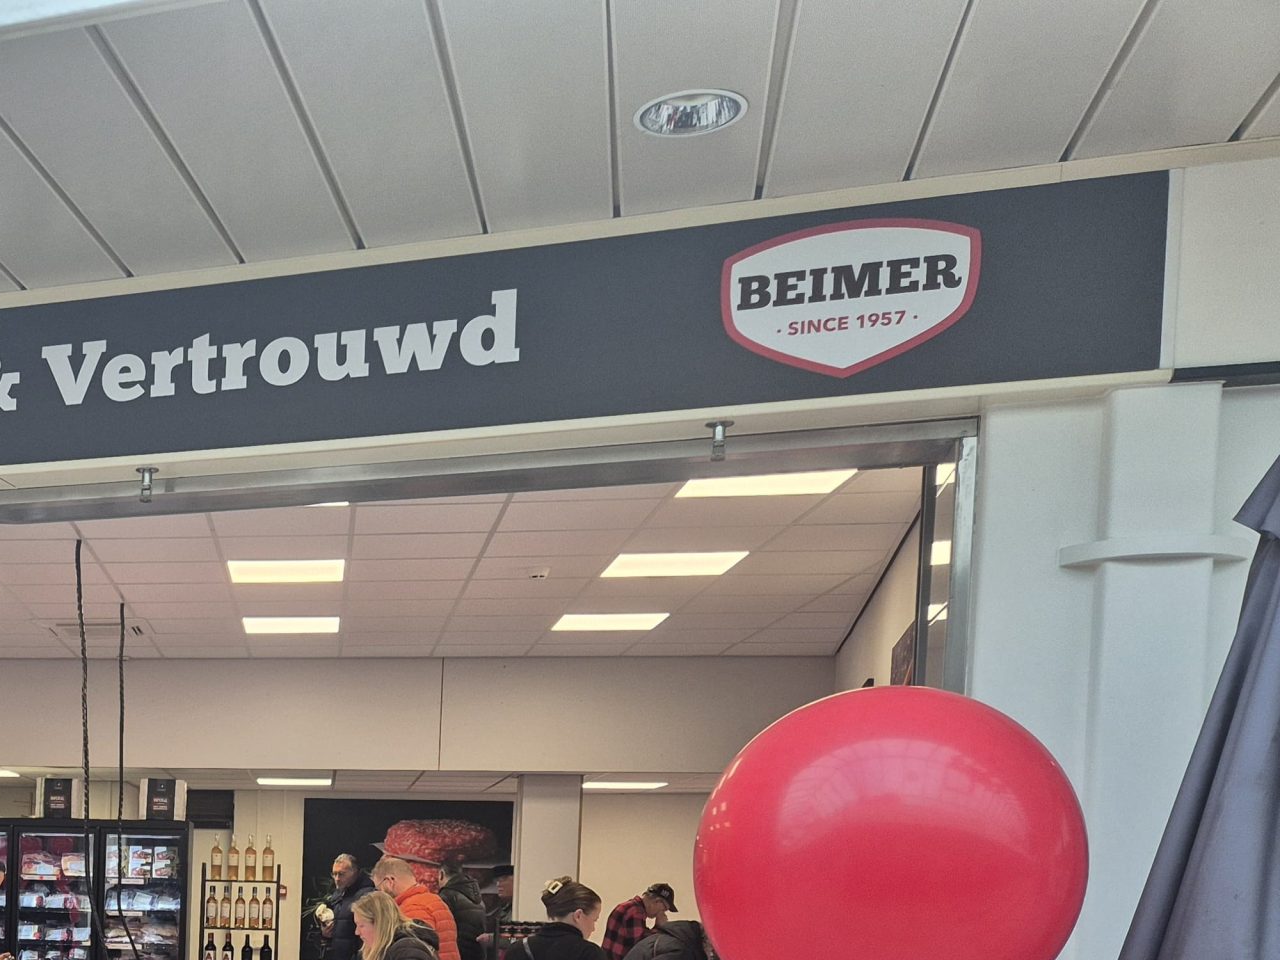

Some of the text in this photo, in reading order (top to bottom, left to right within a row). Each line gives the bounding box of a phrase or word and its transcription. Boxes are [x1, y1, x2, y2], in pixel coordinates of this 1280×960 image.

[736, 253, 963, 311] BEIMER
[41, 288, 521, 407] Vertrouwd
[787, 311, 906, 336] SINCE 1957
